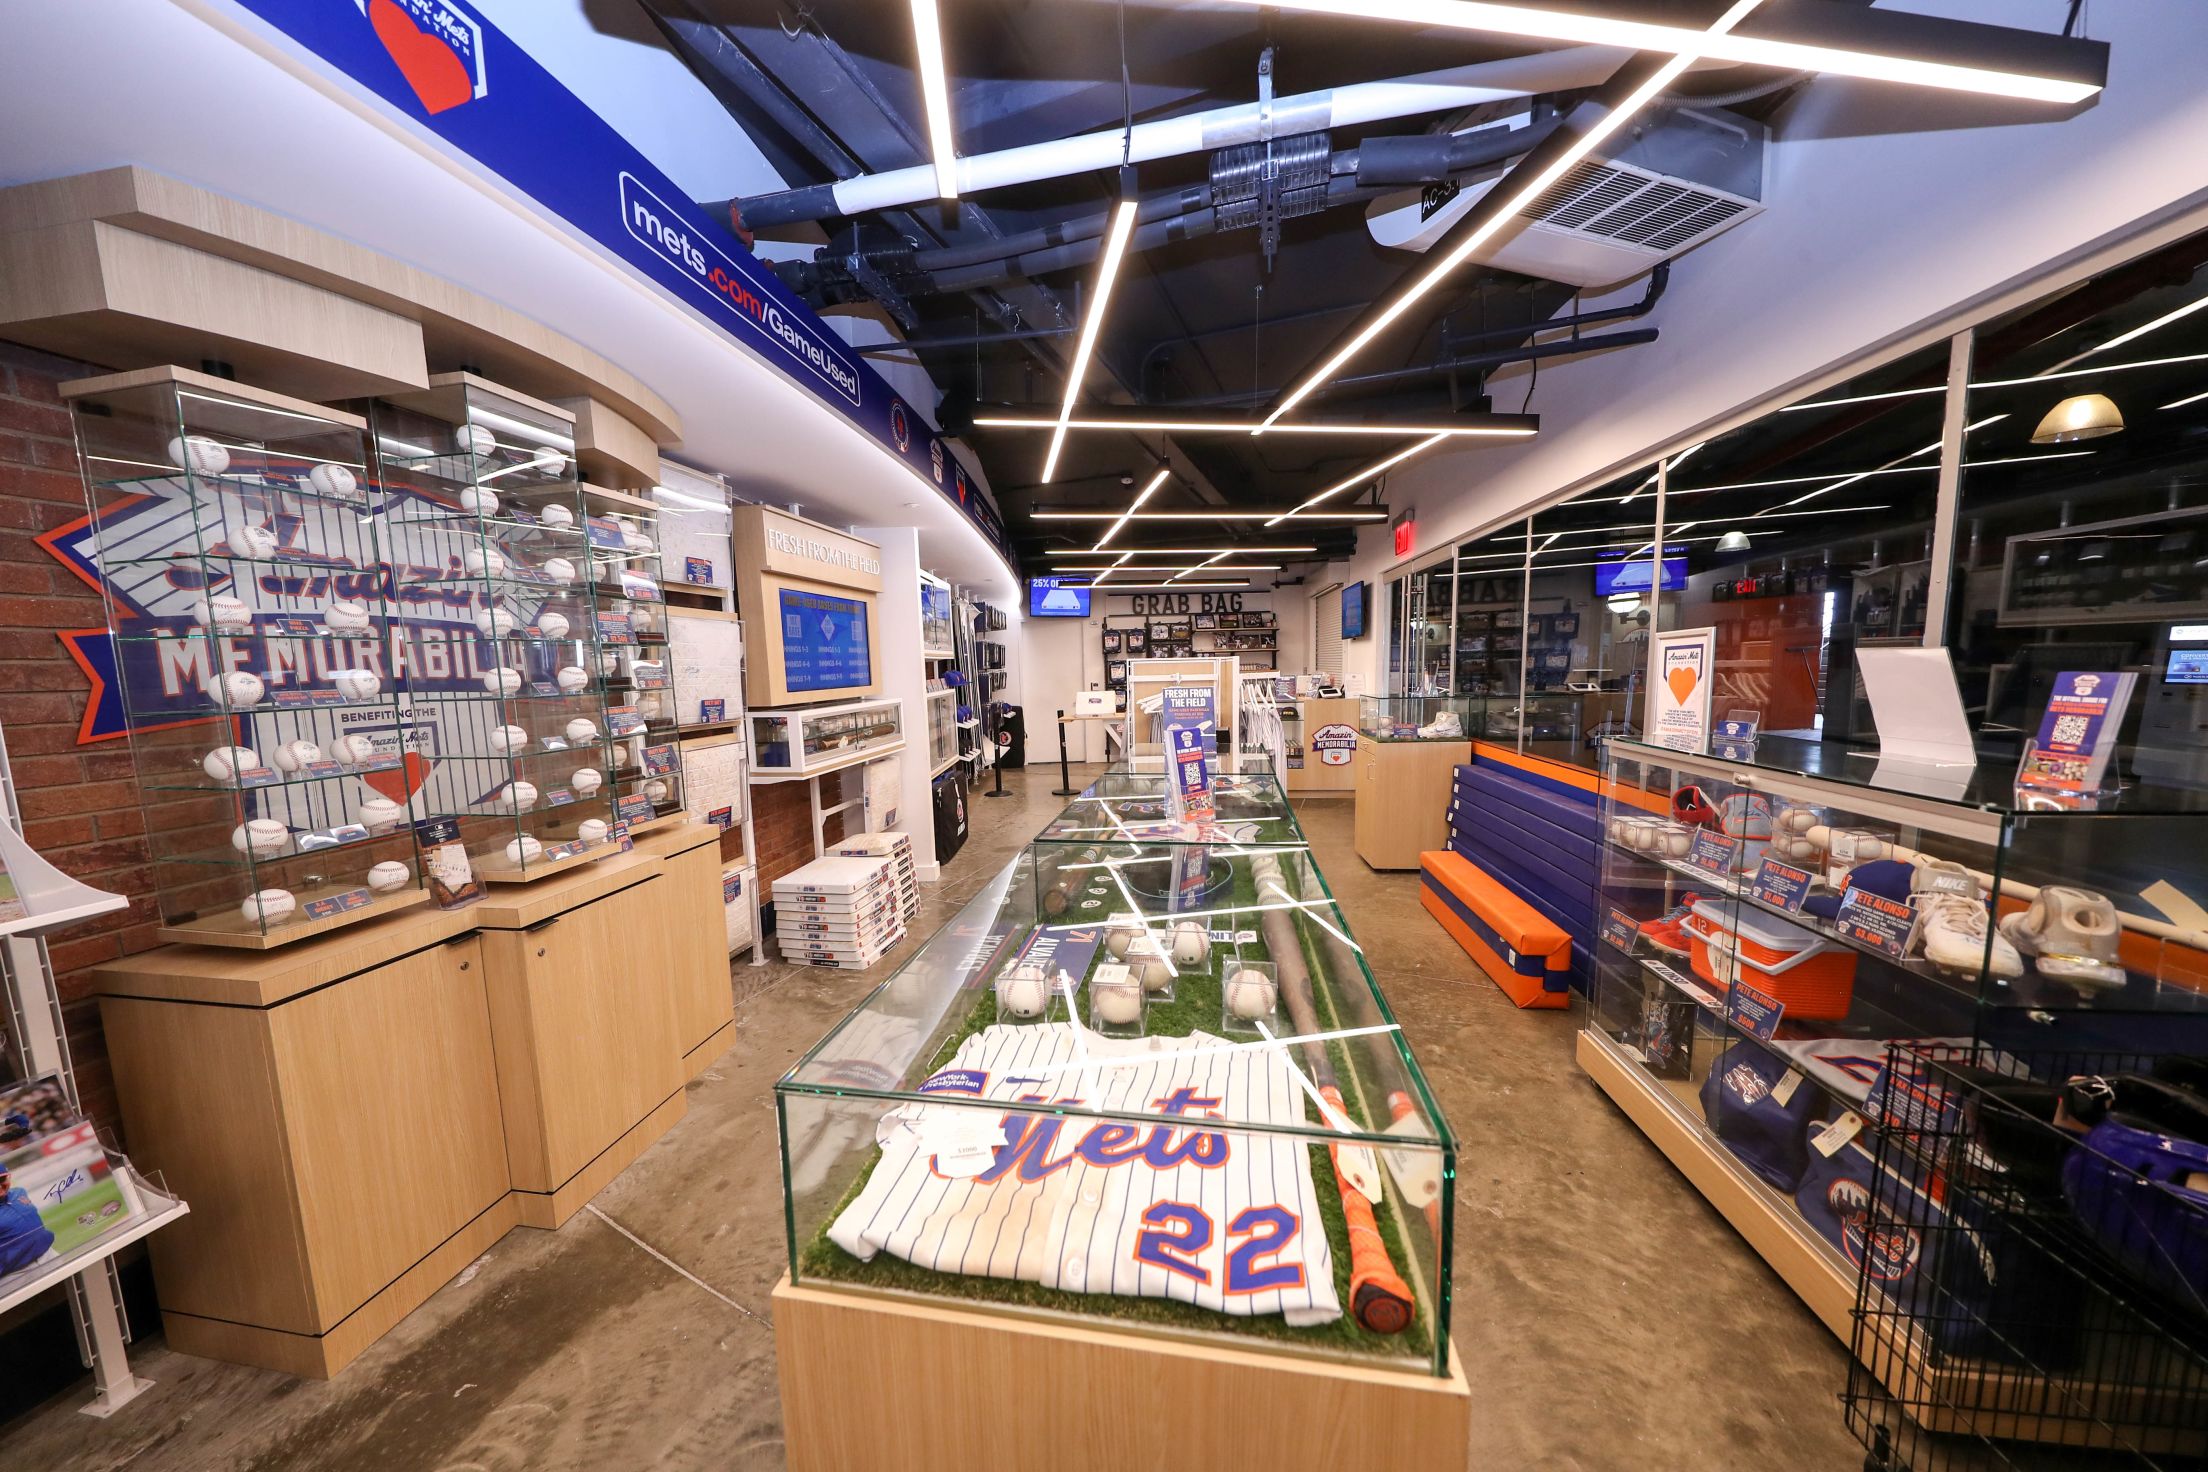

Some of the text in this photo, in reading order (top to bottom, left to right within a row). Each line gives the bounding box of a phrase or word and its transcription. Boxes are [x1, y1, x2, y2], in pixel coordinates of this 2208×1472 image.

[433, 9, 470, 45] Mets
[632, 200, 858, 396] mets.com/GameUsed
[768, 528, 880, 575] FRESH FROM THE FIELD
[1033, 578, 1050, 588] 25%
[1132, 592, 1243, 615] GRAB BAG
[1164, 688, 1211, 698] FRESH FROM
[1171, 698, 1206, 707] THE FIELD
[341, 708, 436, 722] BENEFITING THE
[1319, 730, 1354, 739] Amazin'
[1317, 740, 1356, 749] MEMORABILIA
[1701, 831, 1715, 842] PETE
[1764, 861, 1806, 884] PETE ALONSO
[1932, 876, 1969, 891] NIKE
[1763, 891, 1786, 906] $1,000
[1875, 898, 1910, 919] ALONSO
[1697, 917, 1707, 933] 12
[1855, 927, 1882, 945] $3,000
[1736, 983, 1751, 997] PETE
[1750, 989, 1778, 1011] ALONSO
[1737, 1014, 1755, 1030] $500
[930, 1087, 1230, 1185] Mets
[1133, 1198, 1306, 1295] 22
